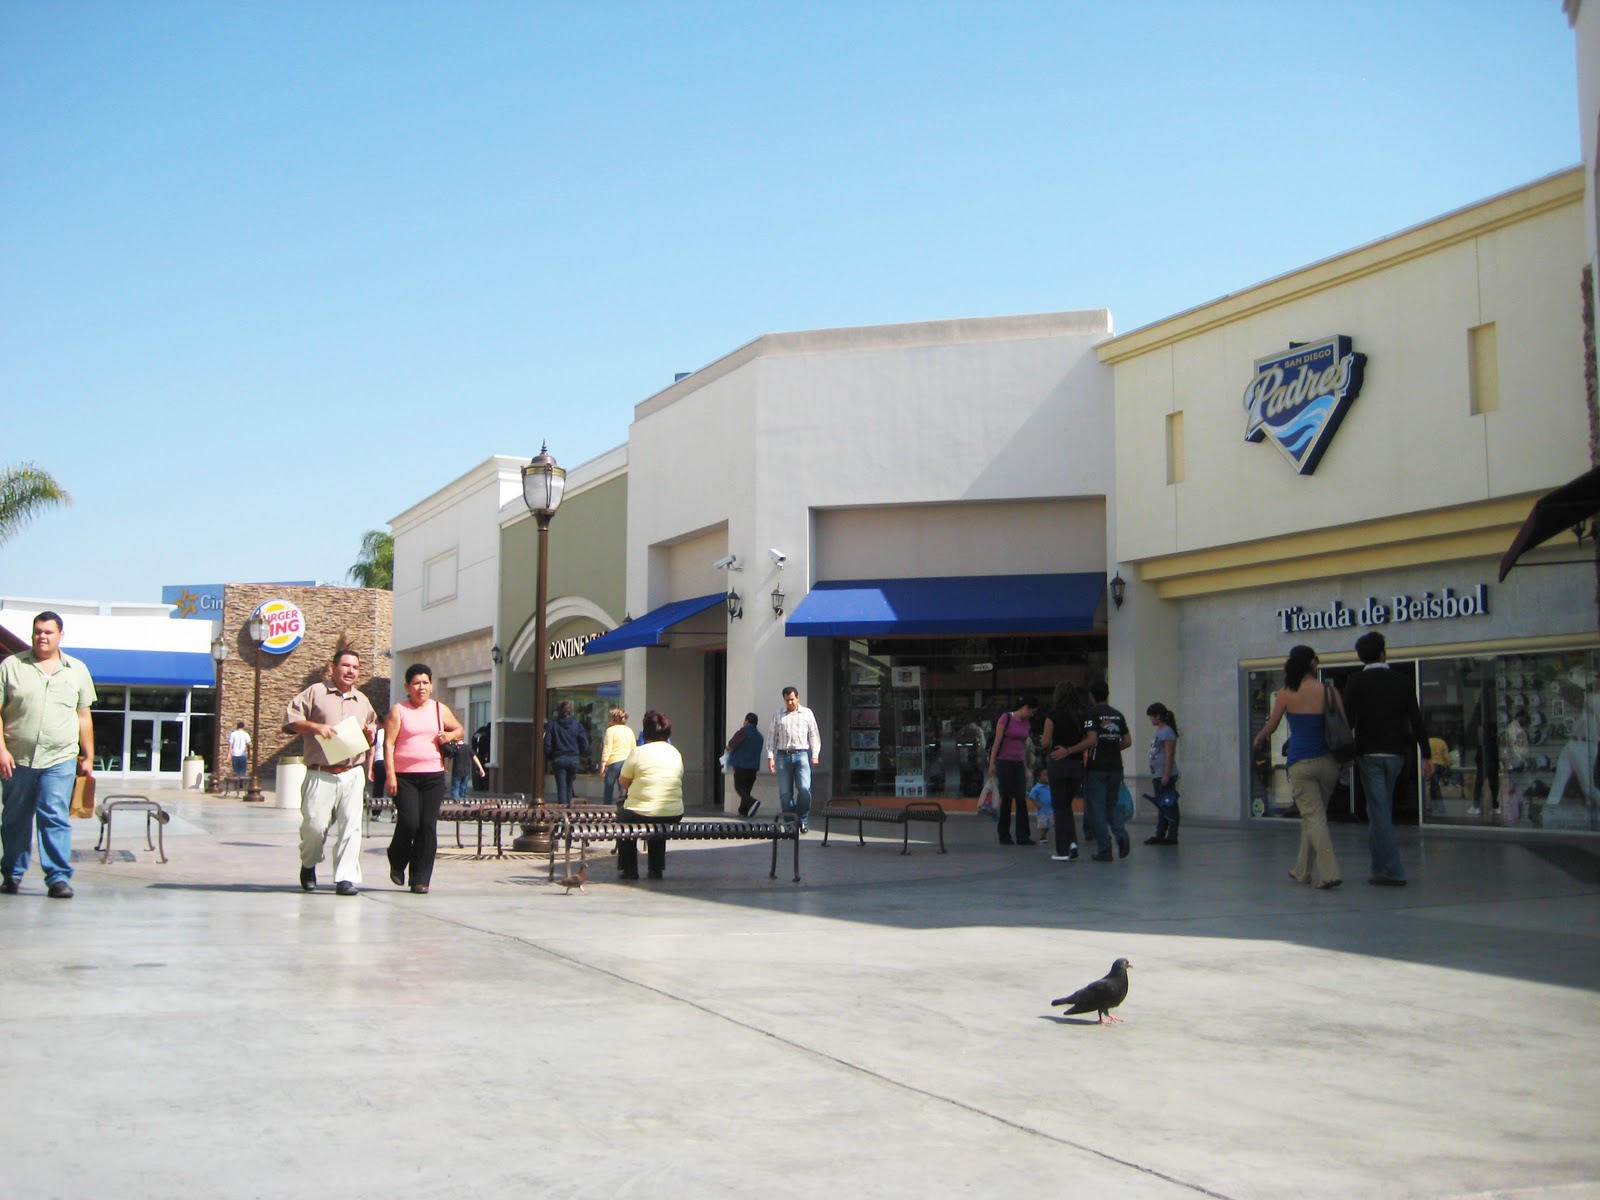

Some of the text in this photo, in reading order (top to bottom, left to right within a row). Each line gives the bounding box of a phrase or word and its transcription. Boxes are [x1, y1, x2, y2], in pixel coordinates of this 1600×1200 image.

[1284, 348, 1332, 369] SAN DIEGO
[1243, 353, 1354, 441] Padres
[265, 609, 298, 623] URGER
[1276, 583, 1488, 633] Tienda de Beisbol
[267, 618, 300, 637] ING
[548, 631, 606, 660] CONTINE
